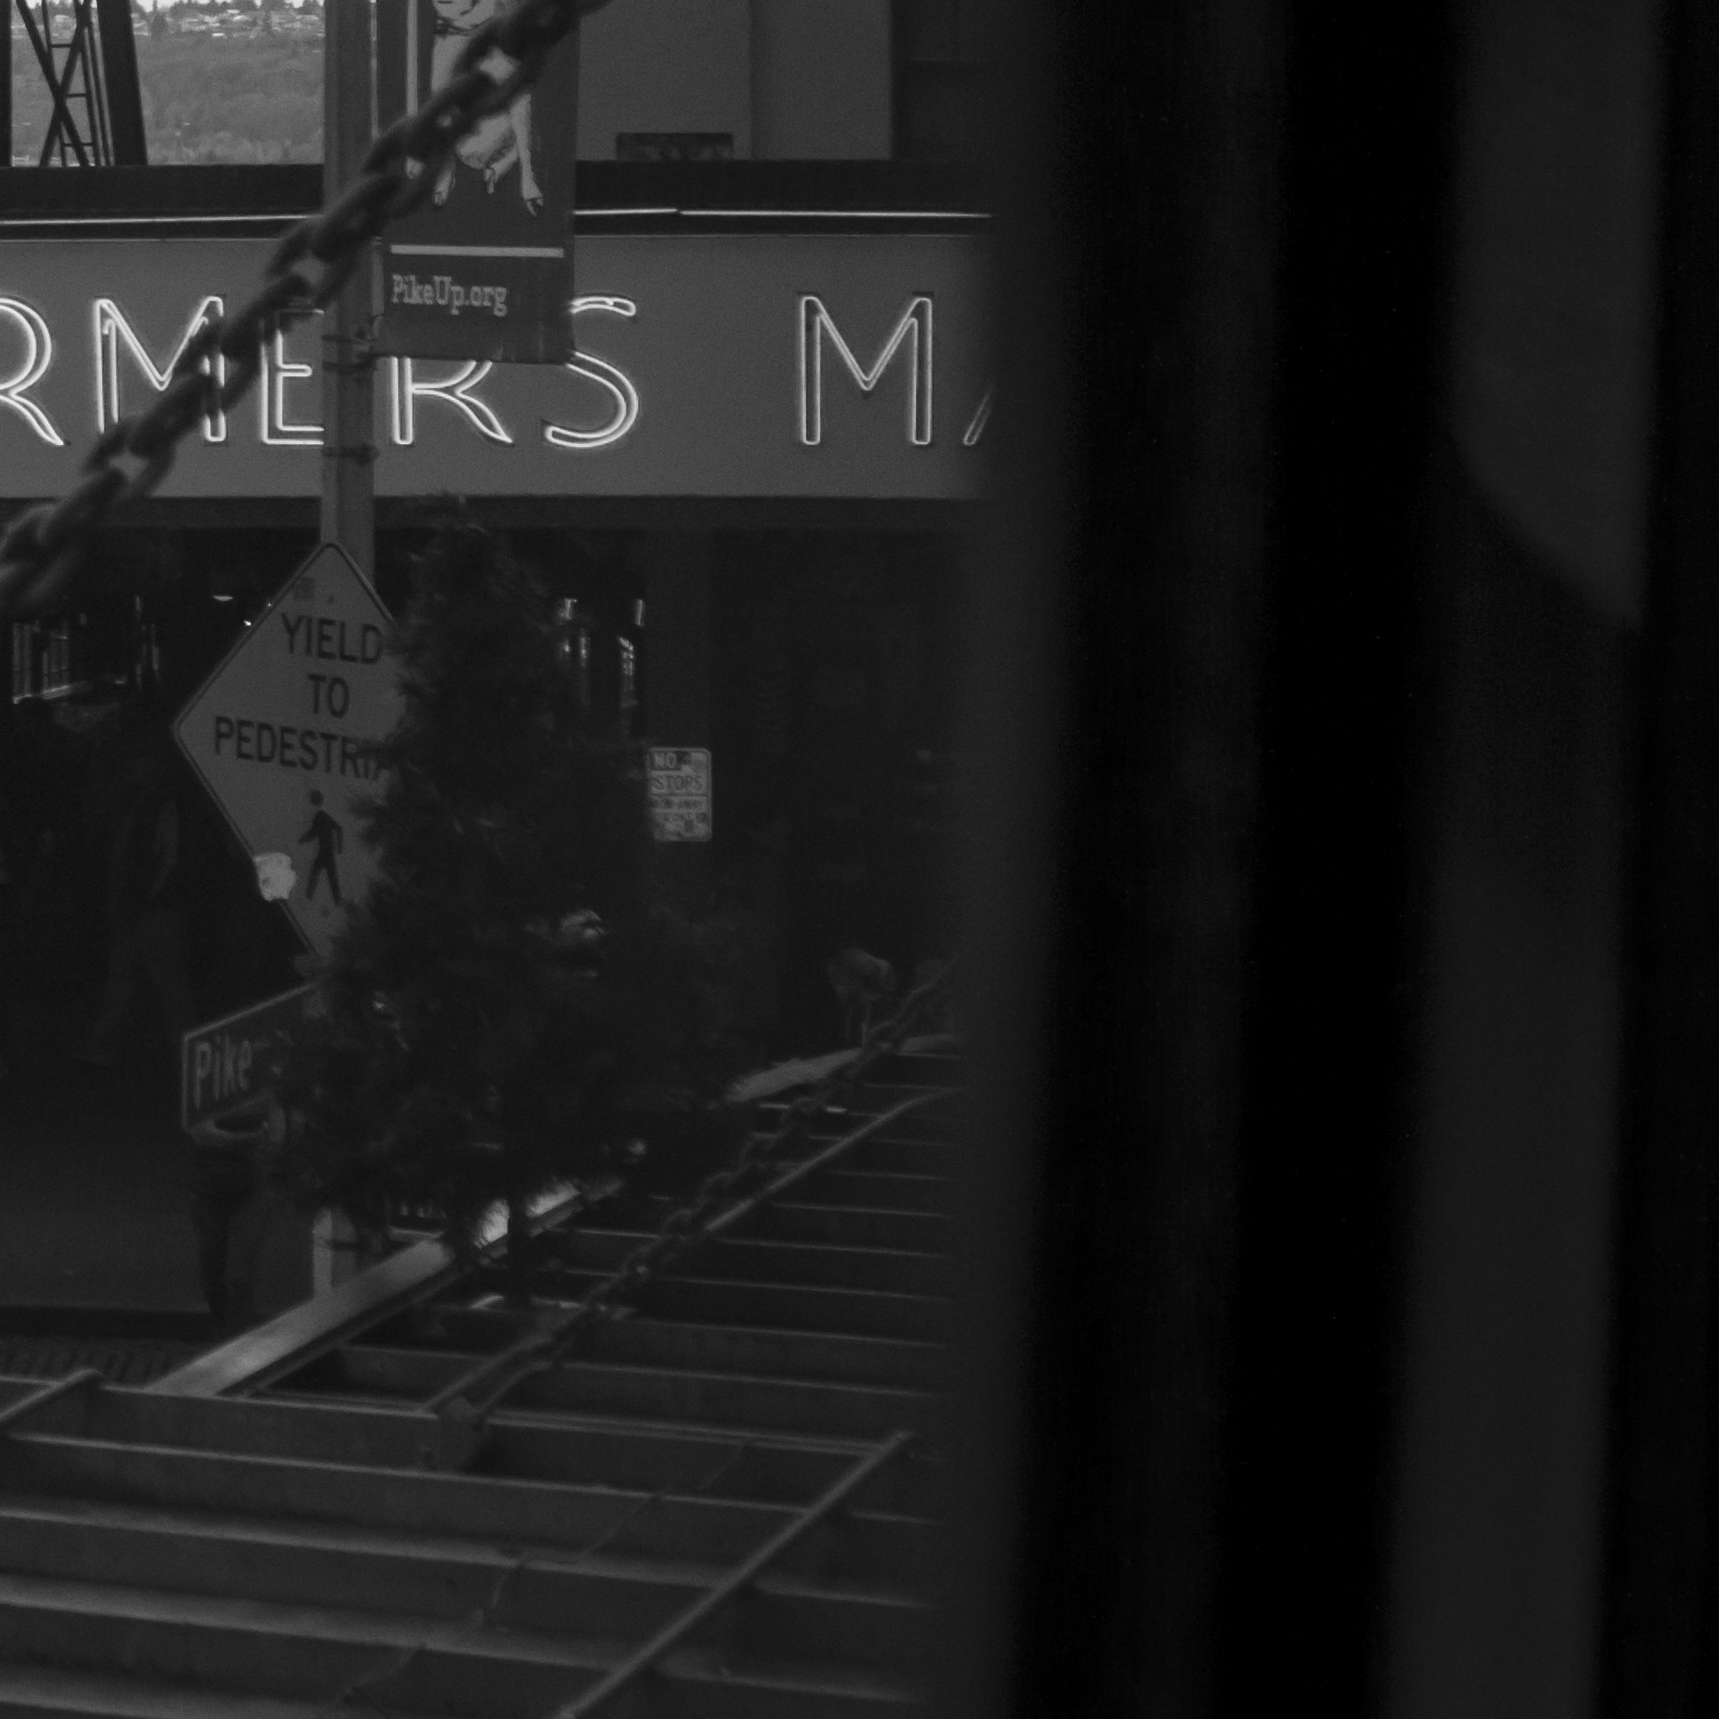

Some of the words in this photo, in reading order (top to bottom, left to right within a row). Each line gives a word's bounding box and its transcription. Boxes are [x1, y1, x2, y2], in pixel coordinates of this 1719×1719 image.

[391, 273, 508, 317] PikeUp.org
[798, 294, 994, 446] M
[281, 613, 384, 665] YIELD
[308, 674, 350, 718] TO
[654, 752, 677, 769] NO
[650, 775, 703, 791] STOPS
[193, 1030, 252, 1110] Pike
